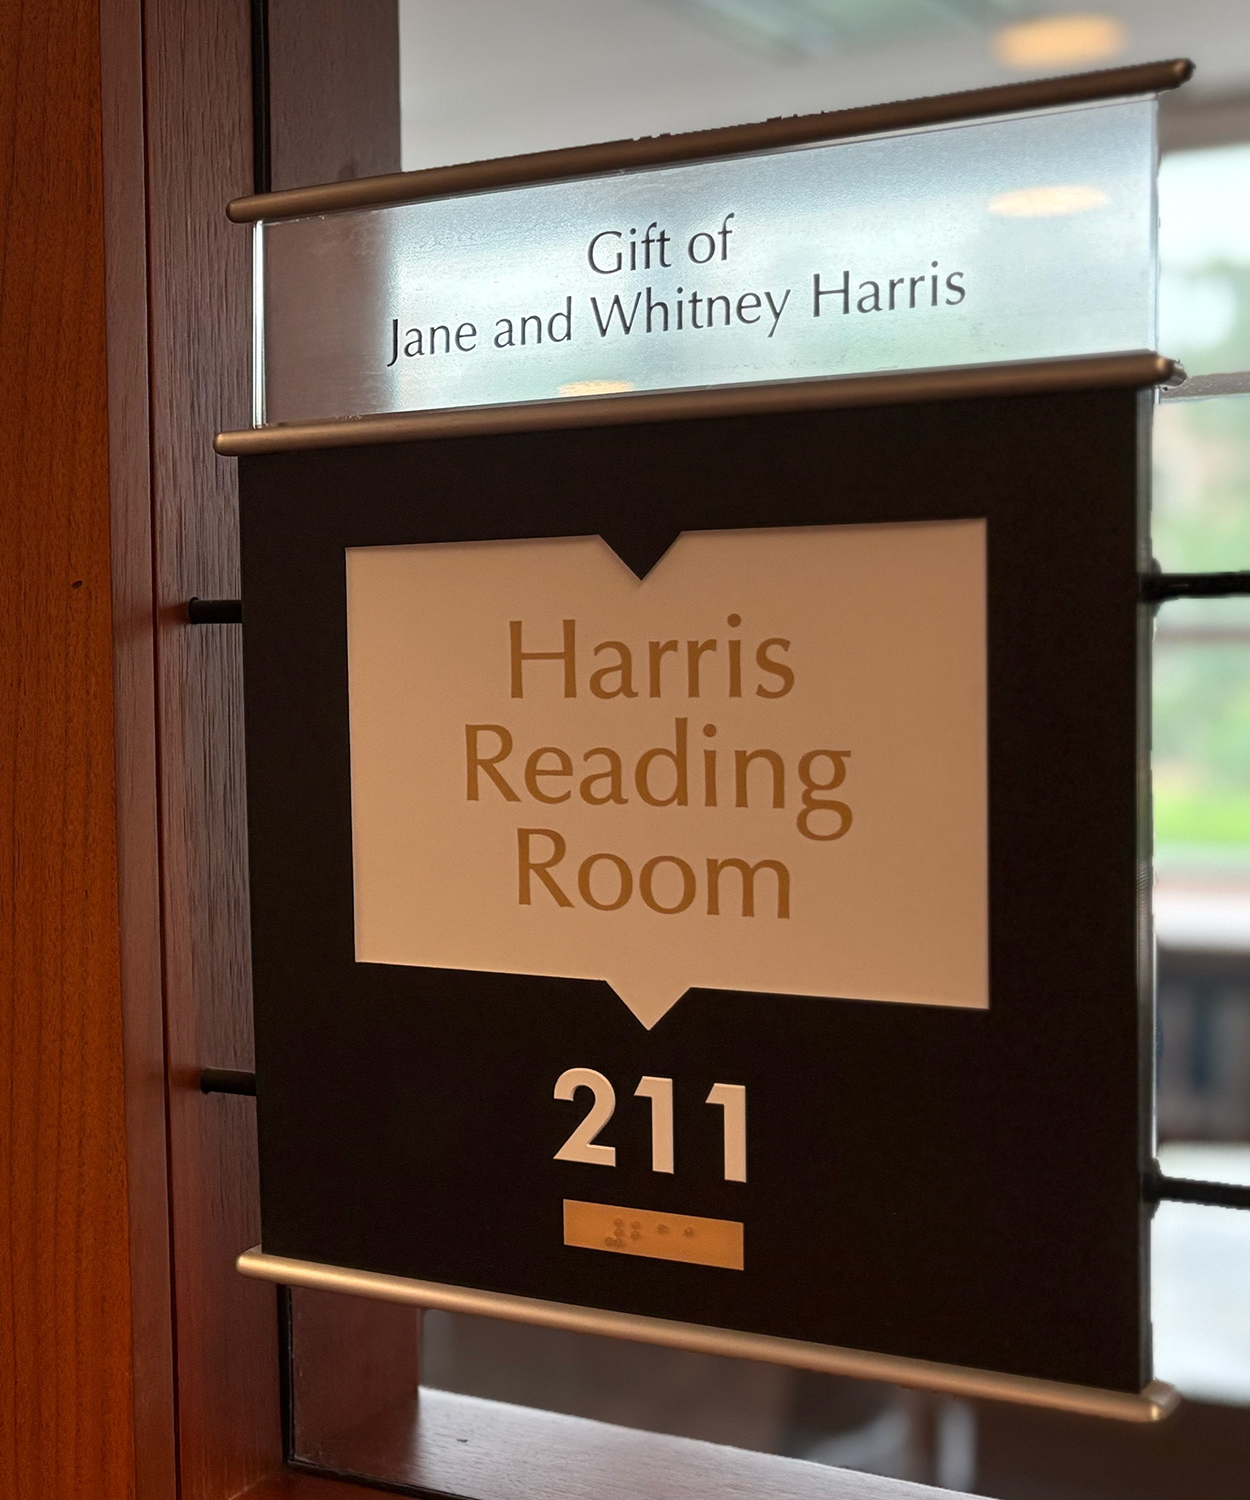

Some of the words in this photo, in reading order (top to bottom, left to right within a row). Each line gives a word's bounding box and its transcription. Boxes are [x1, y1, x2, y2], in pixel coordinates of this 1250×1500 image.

[587, 219, 672, 277] Gift
[686, 212, 735, 266] of
[387, 316, 479, 368] Jane
[492, 295, 573, 350] and
[589, 282, 791, 338] Whitney
[811, 259, 967, 318] Harris
[508, 612, 797, 700] Harris
[464, 717, 854, 842] Reading
[516, 827, 791, 920] Room
[553, 1067, 747, 1183] 211
